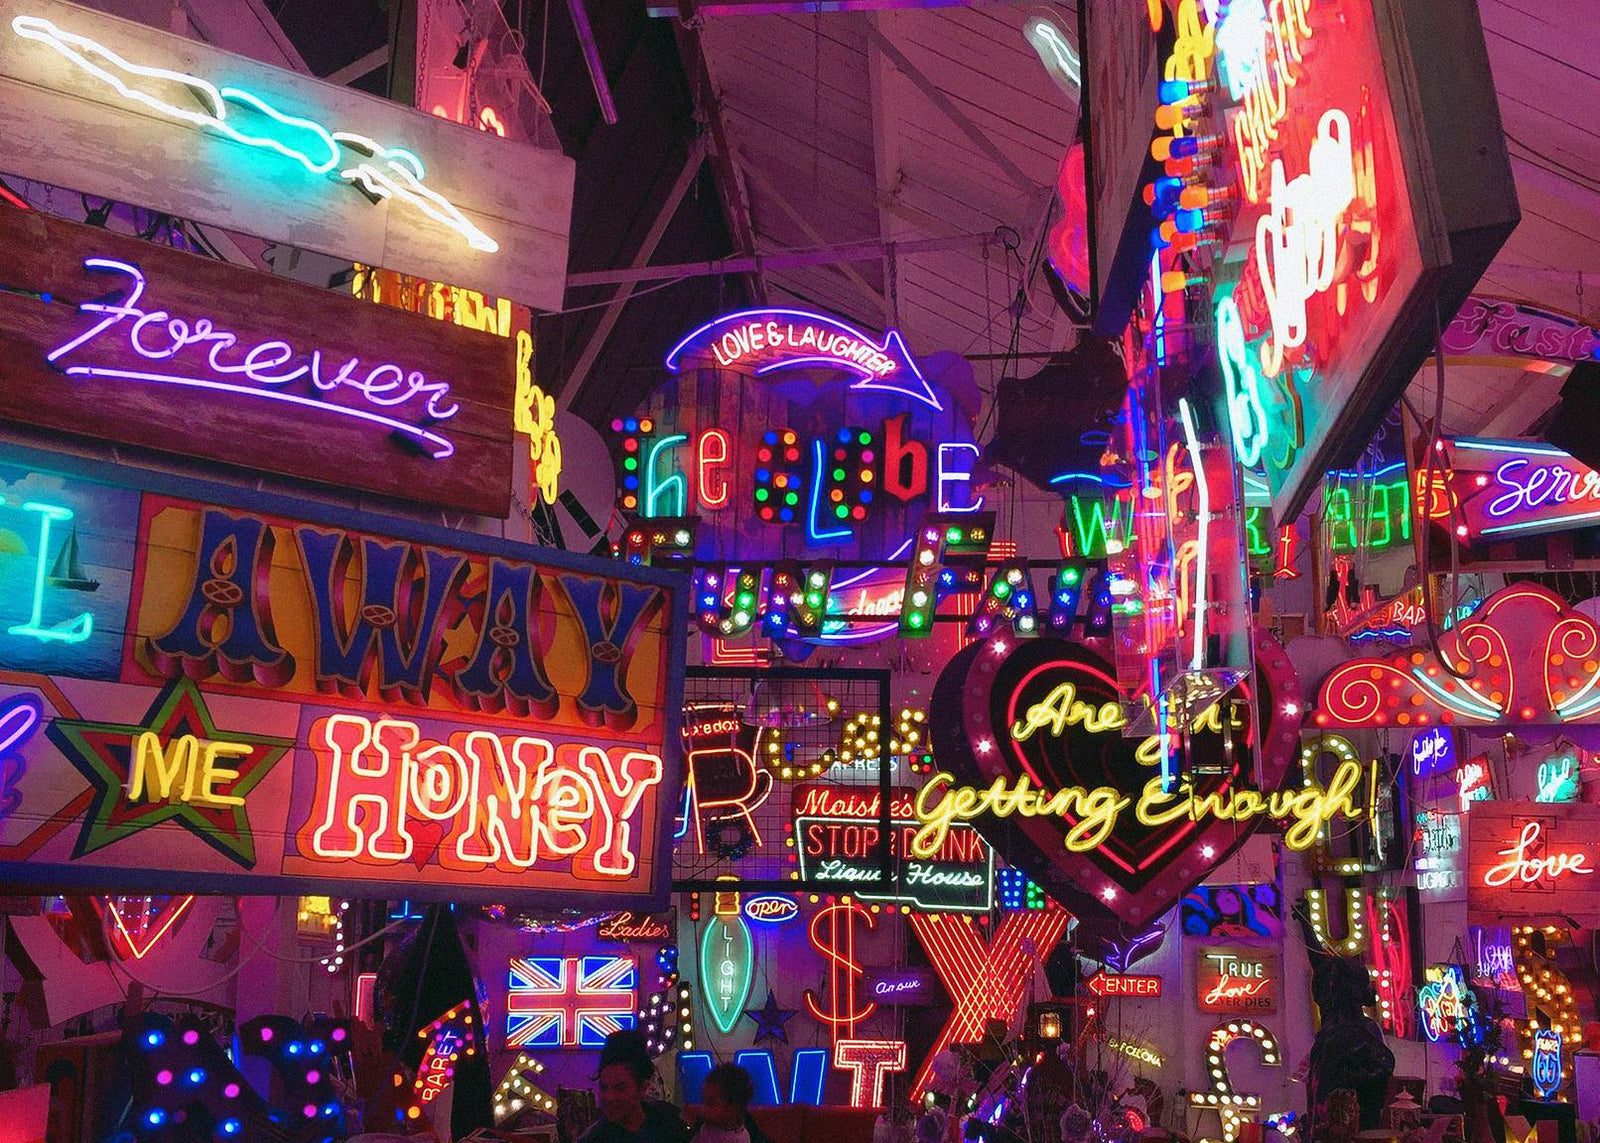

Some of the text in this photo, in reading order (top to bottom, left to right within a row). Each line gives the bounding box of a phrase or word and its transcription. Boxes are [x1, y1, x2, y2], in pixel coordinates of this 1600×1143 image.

[47, 258, 459, 420] Forever
[1489, 458, 1600, 516] Serv
[145, 504, 668, 732] AWAY
[1011, 681, 1127, 741] Are
[127, 730, 255, 808] ME
[807, 823, 880, 858] STOP
[902, 826, 987, 864] DINK
[912, 772, 1129, 857] Getting
[814, 858, 986, 886] Liqu House
[1484, 821, 1594, 887] Love
[598, 911, 670, 938] Ladies
[719, 924, 734, 1013] LIGHT
[1105, 977, 1158, 994] ENTER
[1204, 973, 1271, 1005] Love
[1205, 953, 1264, 979] TRUE
[1243, 996, 1271, 1008] DIES
